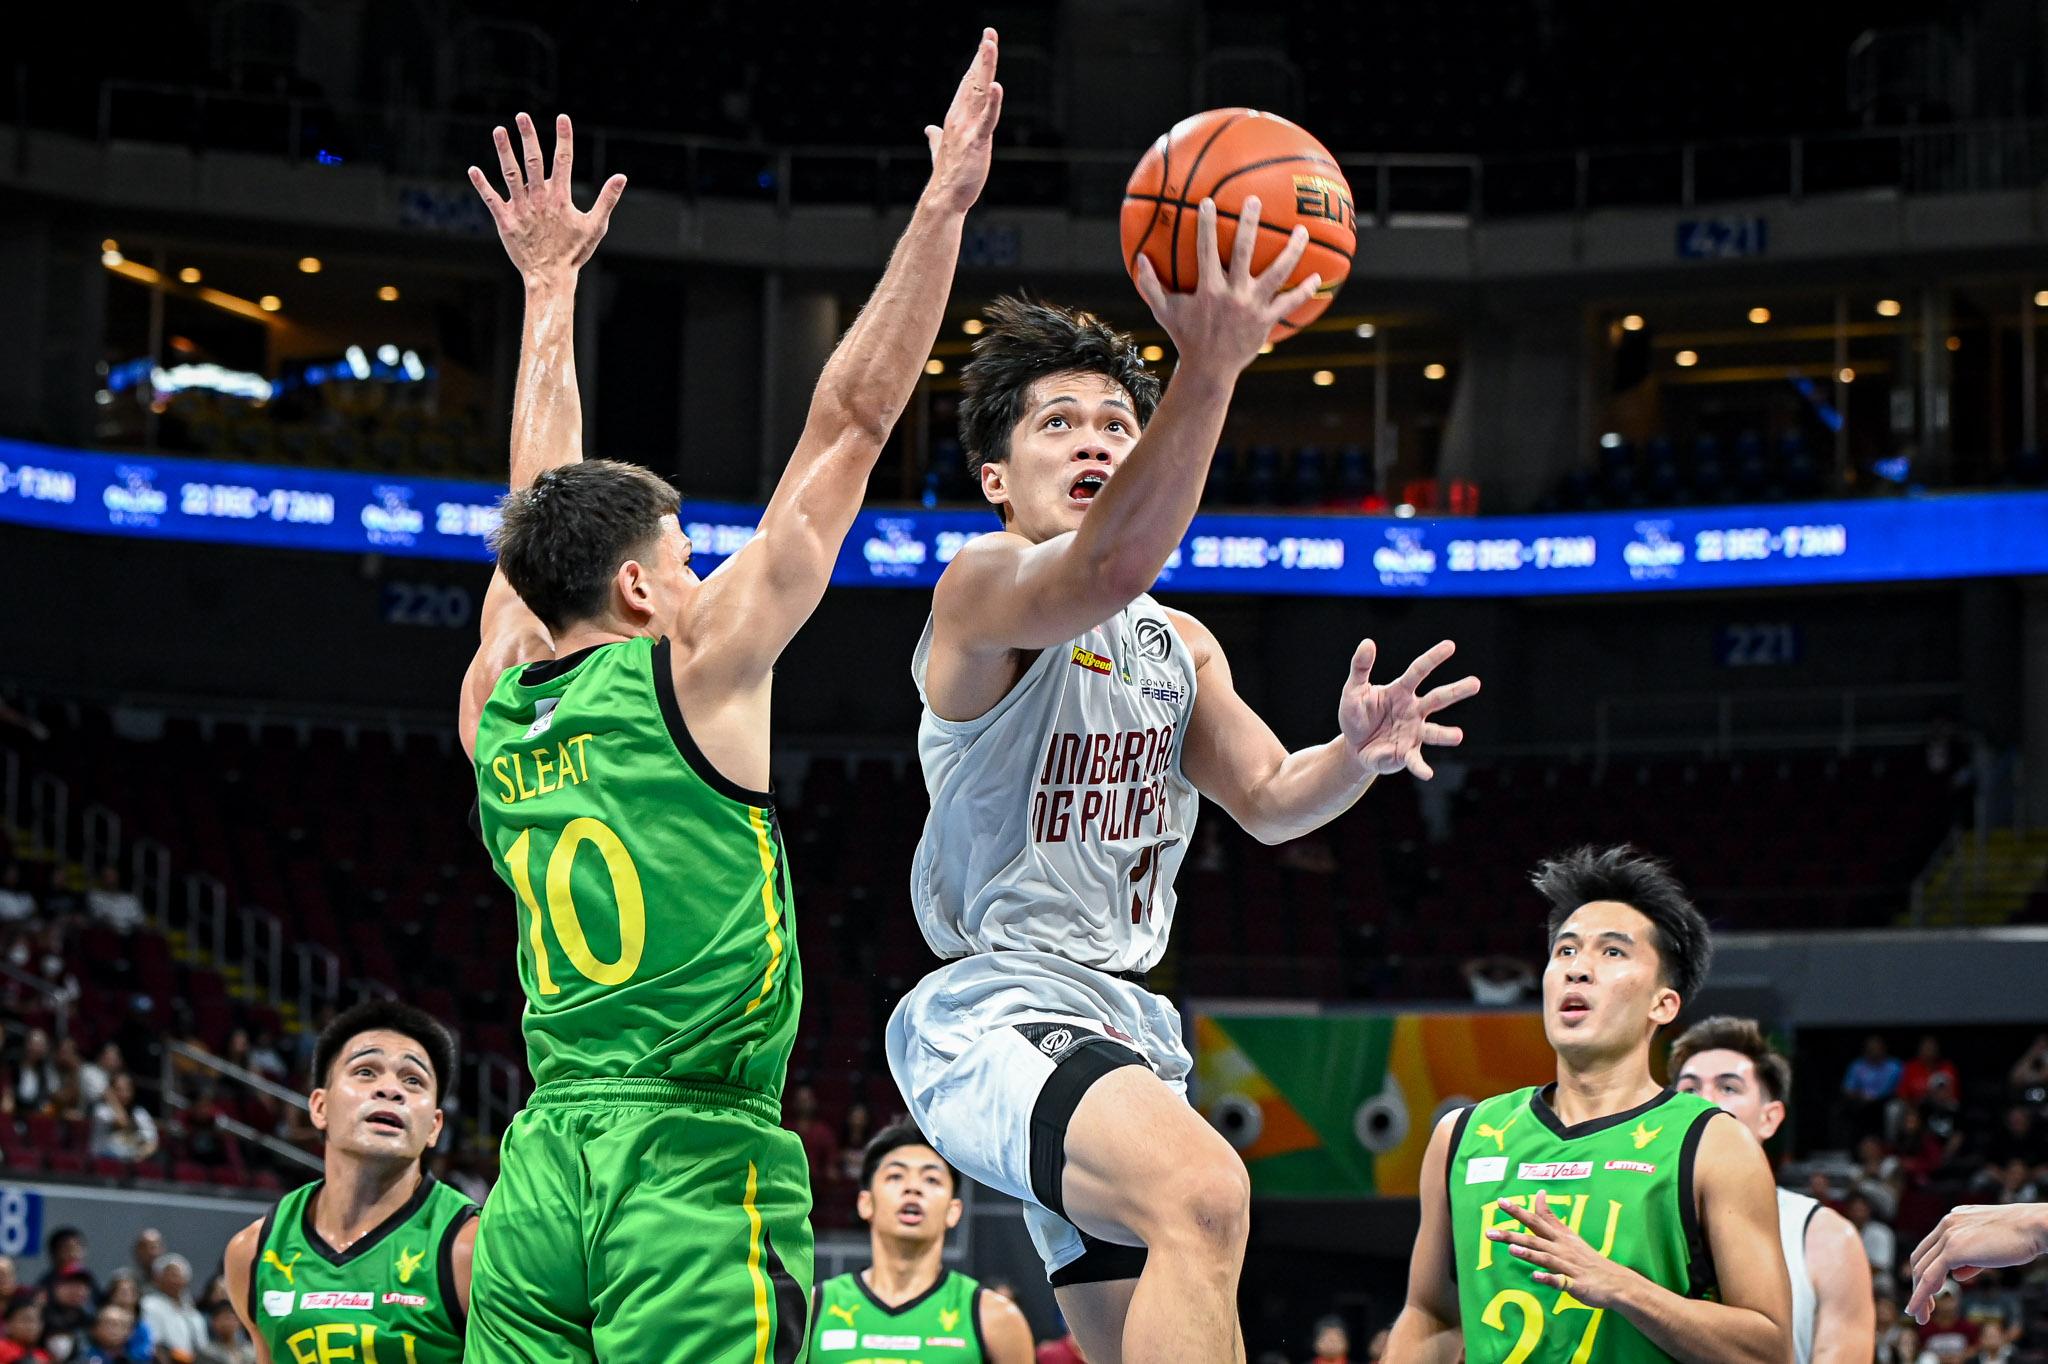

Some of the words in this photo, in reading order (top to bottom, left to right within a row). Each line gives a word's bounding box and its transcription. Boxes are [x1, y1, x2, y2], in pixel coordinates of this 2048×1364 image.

[1296, 184, 1355, 232] ELIT
[492, 733, 593, 804] SLEAT
[503, 816, 646, 996] 10
[1480, 1289, 1604, 1364] 27
